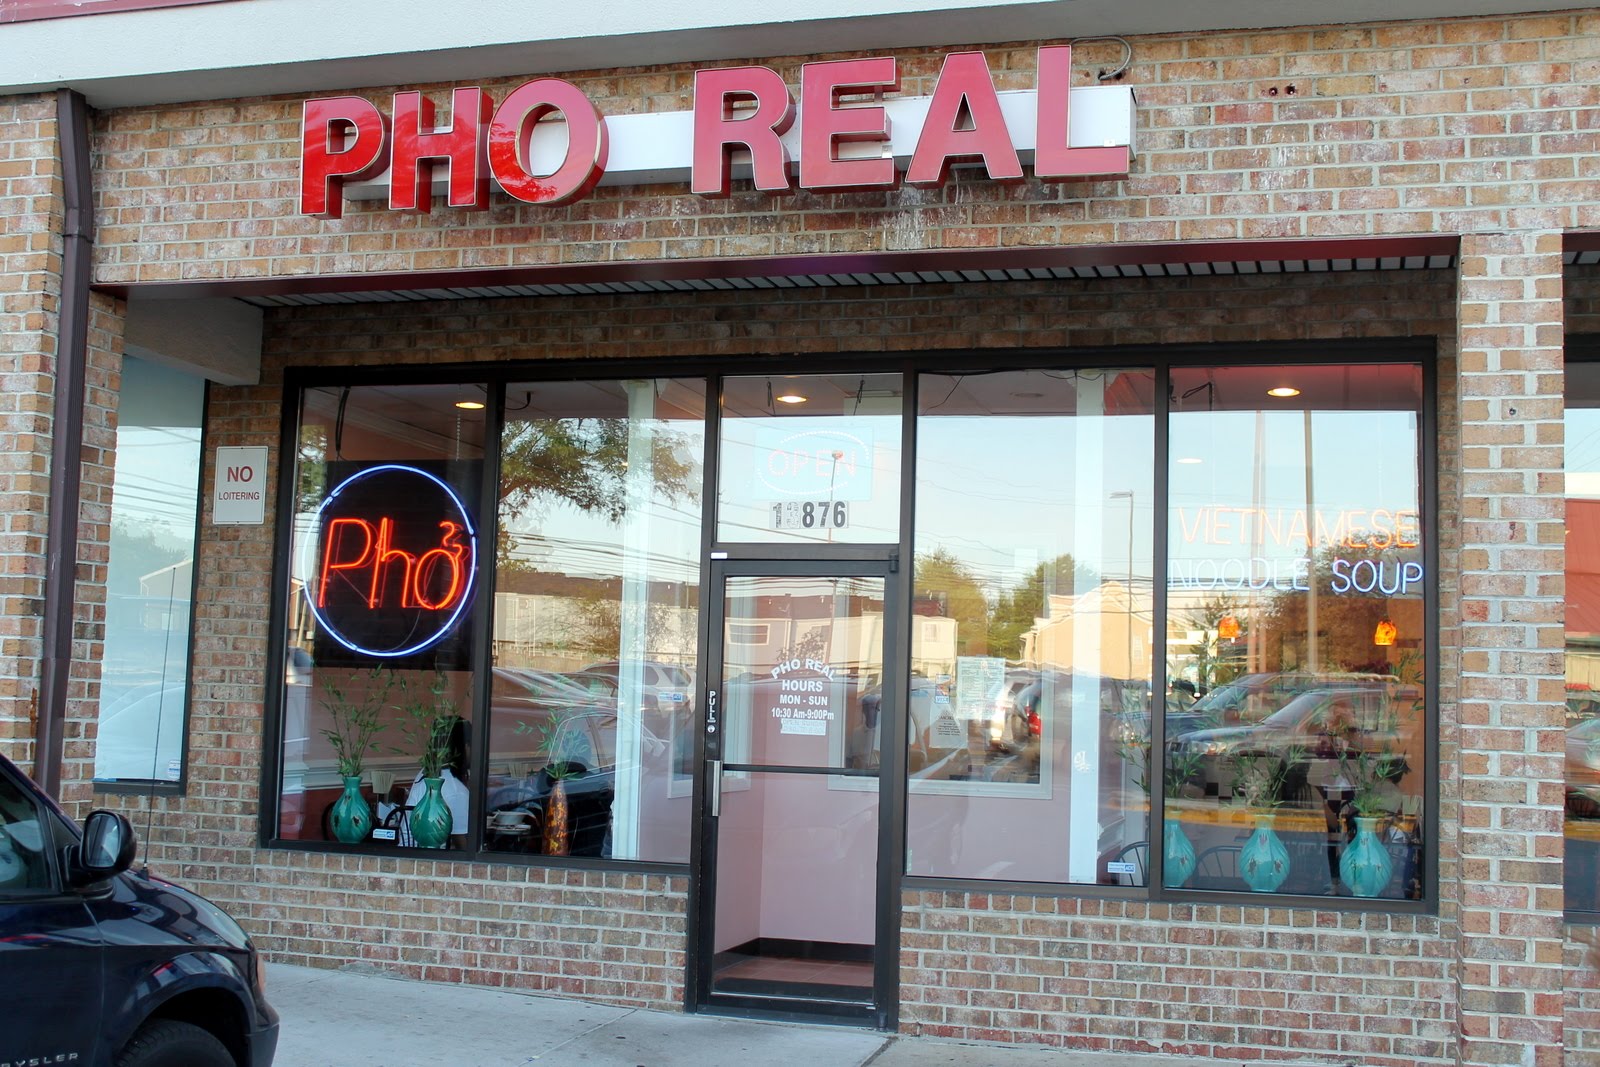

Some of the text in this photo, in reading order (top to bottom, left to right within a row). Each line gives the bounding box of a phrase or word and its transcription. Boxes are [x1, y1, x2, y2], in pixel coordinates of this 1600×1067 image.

[300, 45, 1131, 218] PHO REAL
[227, 466, 253, 482] NO
[767, 449, 857, 477] OPEN
[218, 491, 260, 501] LOITERING
[1178, 506, 1418, 548] VIETNAMESE
[1169, 558, 1424, 595] NOODLE SOUP
[771, 658, 834, 681] PHO REAL
[782, 680, 823, 692] HOURS
[708, 690, 717, 720] PULL
[779, 694, 801, 705] MON
[808, 696, 829, 706] SUN
[771, 707, 792, 718] 10:30
